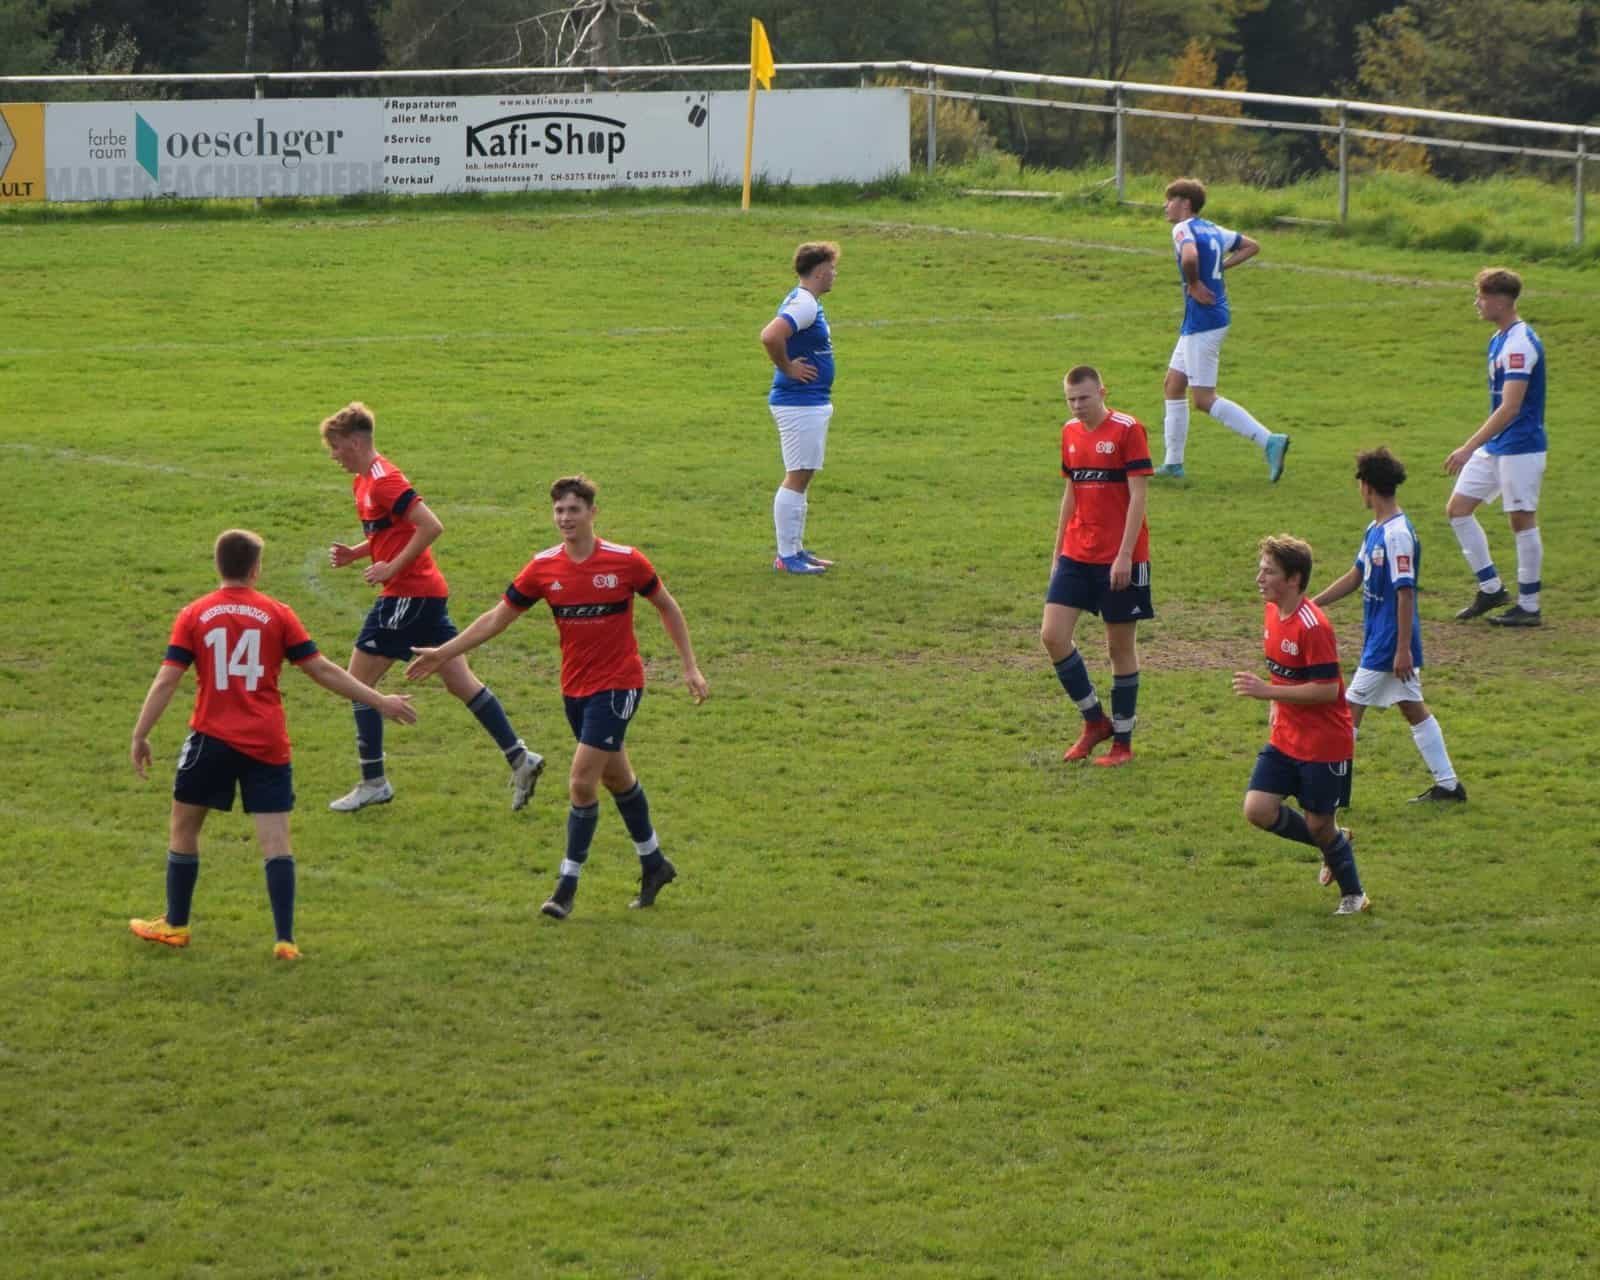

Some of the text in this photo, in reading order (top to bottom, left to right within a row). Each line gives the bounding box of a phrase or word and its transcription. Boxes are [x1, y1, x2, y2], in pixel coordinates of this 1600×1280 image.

[392, 113, 459, 123] aller Marken
[88, 128, 127, 146] farbe
[166, 118, 344, 169] oeschger
[466, 123, 626, 164] Kafi-Shop
[89, 149, 127, 160] raum
[0, 182, 33, 197] ULT
[204, 627, 265, 692] 14
